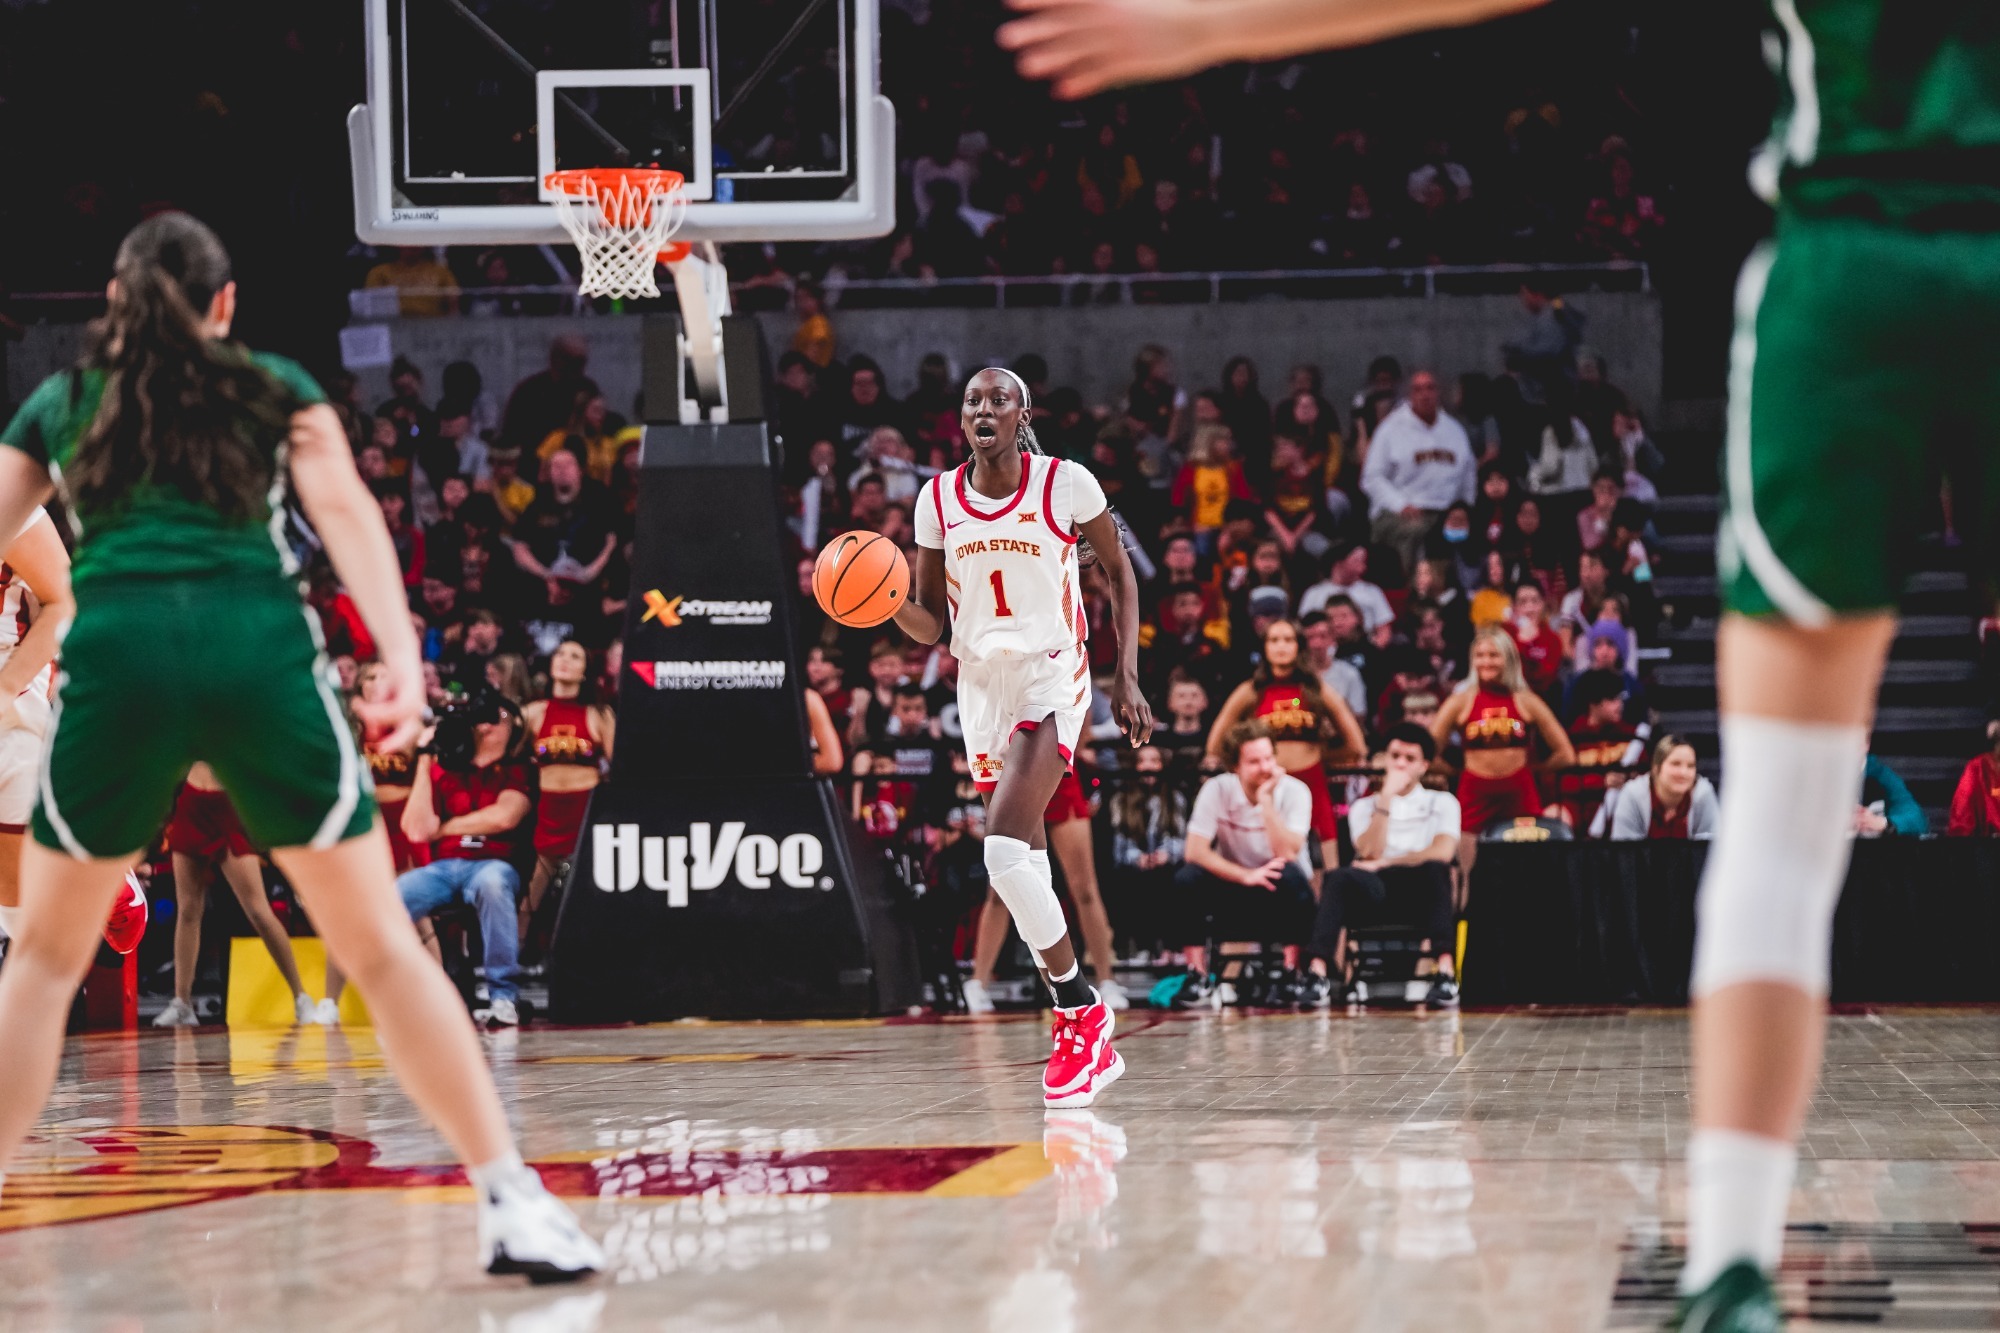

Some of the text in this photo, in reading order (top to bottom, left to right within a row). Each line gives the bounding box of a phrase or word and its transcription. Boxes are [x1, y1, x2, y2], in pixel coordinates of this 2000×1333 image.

[955, 538, 1041, 561] IOWA STATE
[989, 569, 1013, 617] 1
[654, 660, 786, 678] MIDAMERICAN
[656, 676, 785, 690] ENERGY COMPANY
